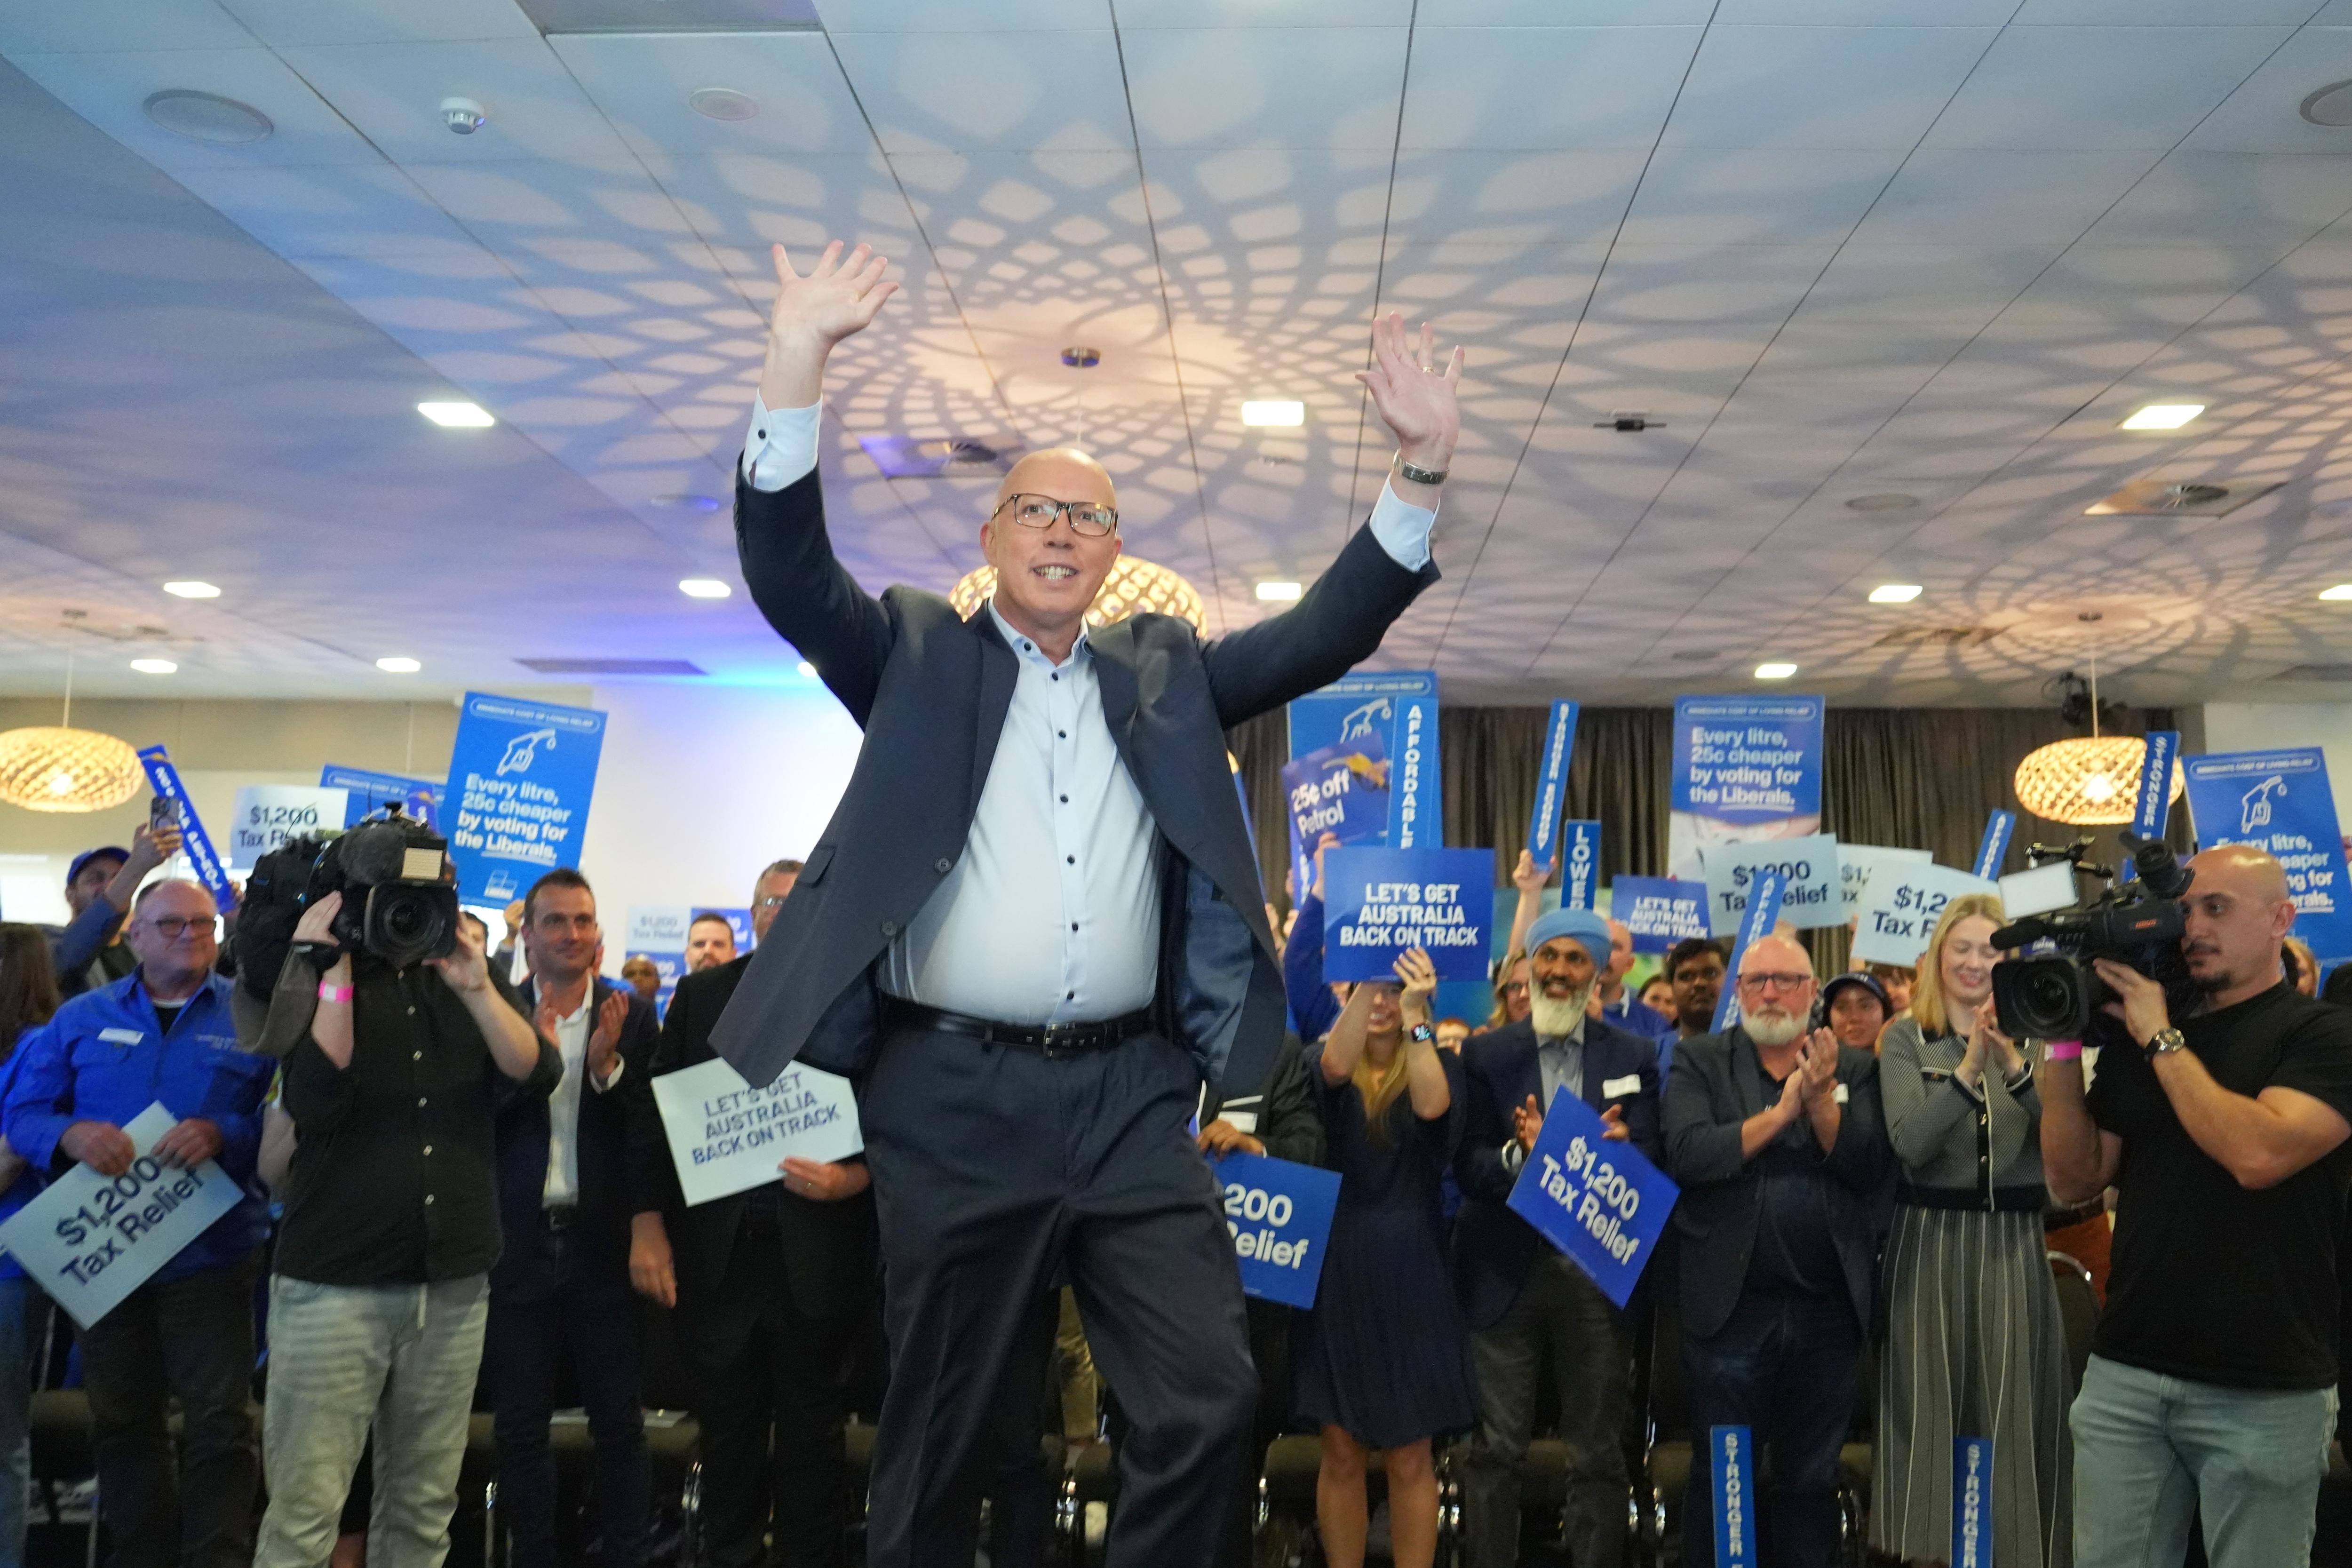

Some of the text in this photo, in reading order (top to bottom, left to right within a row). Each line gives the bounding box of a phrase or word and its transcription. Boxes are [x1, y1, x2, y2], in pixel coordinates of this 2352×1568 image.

[1691, 726, 1788, 748] Every litre,
[1691, 746, 1803, 768] 25c cheaper
[466, 773, 559, 806] Every litre,
[1322, 768, 1350, 798] off
[1690, 765, 1803, 788] by voting for
[2144, 736, 2167, 827] STRONGER
[461, 791, 572, 823] 25c cheaper
[1690, 786, 1796, 805] the Liberals.
[250, 805, 318, 828] $1,200
[457, 809, 569, 842] by voting for
[1297, 799, 1344, 838] Petrol
[238, 828, 265, 847] Tax
[454, 828, 558, 860] the Liberals.
[2271, 833, 2312, 852] litre,
[2279, 852, 2329, 871] eaper
[1365, 883, 1460, 904] LET'S GET
[2308, 869, 2334, 887] for
[1636, 896, 1697, 912] LET'S GET
[1720, 891, 1746, 913] Ta
[1782, 882, 1829, 907] elief
[1894, 883, 1948, 915] $1,2
[1358, 904, 1465, 925] AUSTRALIA
[1631, 909, 1700, 926] AUSTRALIA
[1873, 909, 1914, 938] Tax
[1340, 925, 1479, 947] BACK ON TRACK
[1653, 923, 1670, 936] ON
[1672, 924, 1708, 939] TRACK
[704, 1071, 802, 1118] LET'S GET
[706, 1090, 818, 1140] AUSTRALIA
[692, 1102, 841, 1166] BACK ON TRACK
[1565, 1136, 1640, 1221] $1,200
[55, 1156, 161, 1246] $1,200
[1224, 1183, 1293, 1227] 200
[1540, 1153, 1580, 1213] Tax
[1576, 1192, 1640, 1266] Relief
[59, 1167, 204, 1286] Tax Relief
[1227, 1220, 1309, 1269] elief
[1725, 1433, 1742, 1557] STRONGER
[1963, 1444, 1980, 1568] STRONGER
